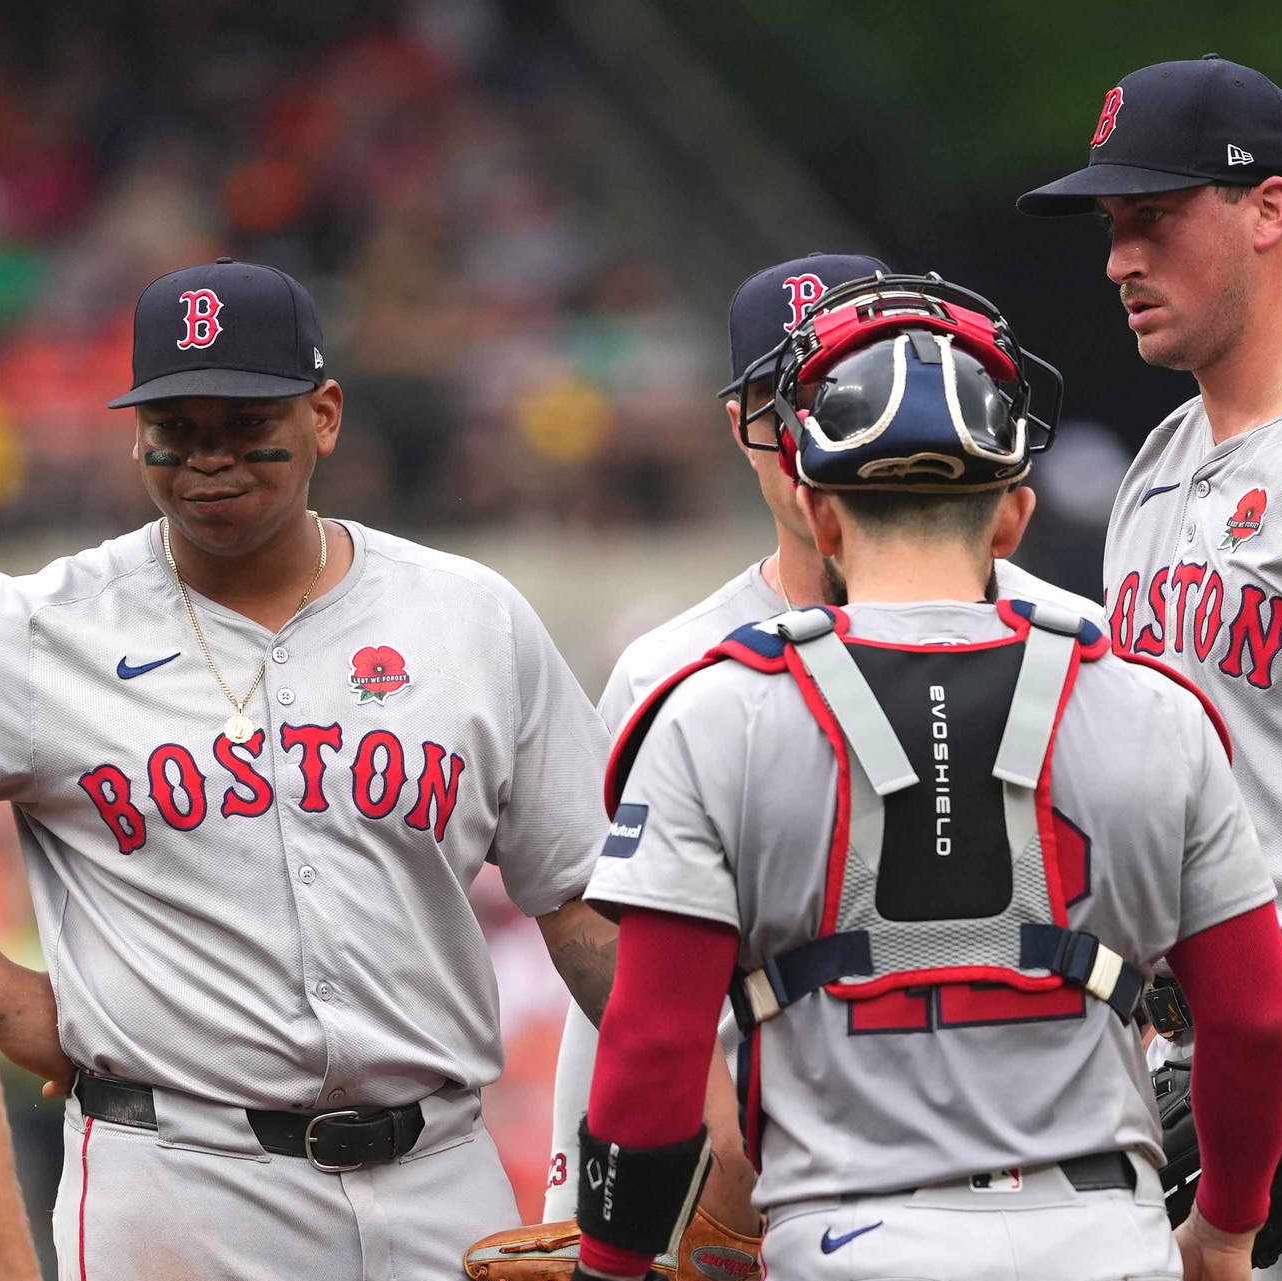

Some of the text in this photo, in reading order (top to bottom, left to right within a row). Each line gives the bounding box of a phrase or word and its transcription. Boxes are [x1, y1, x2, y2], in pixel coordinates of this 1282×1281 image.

[1090, 86, 1125, 150] B
[177, 288, 225, 350] B
[382, 674, 407, 682] FORGET
[78, 721, 466, 855] BOSTON
[547, 1152, 567, 1188] 3
